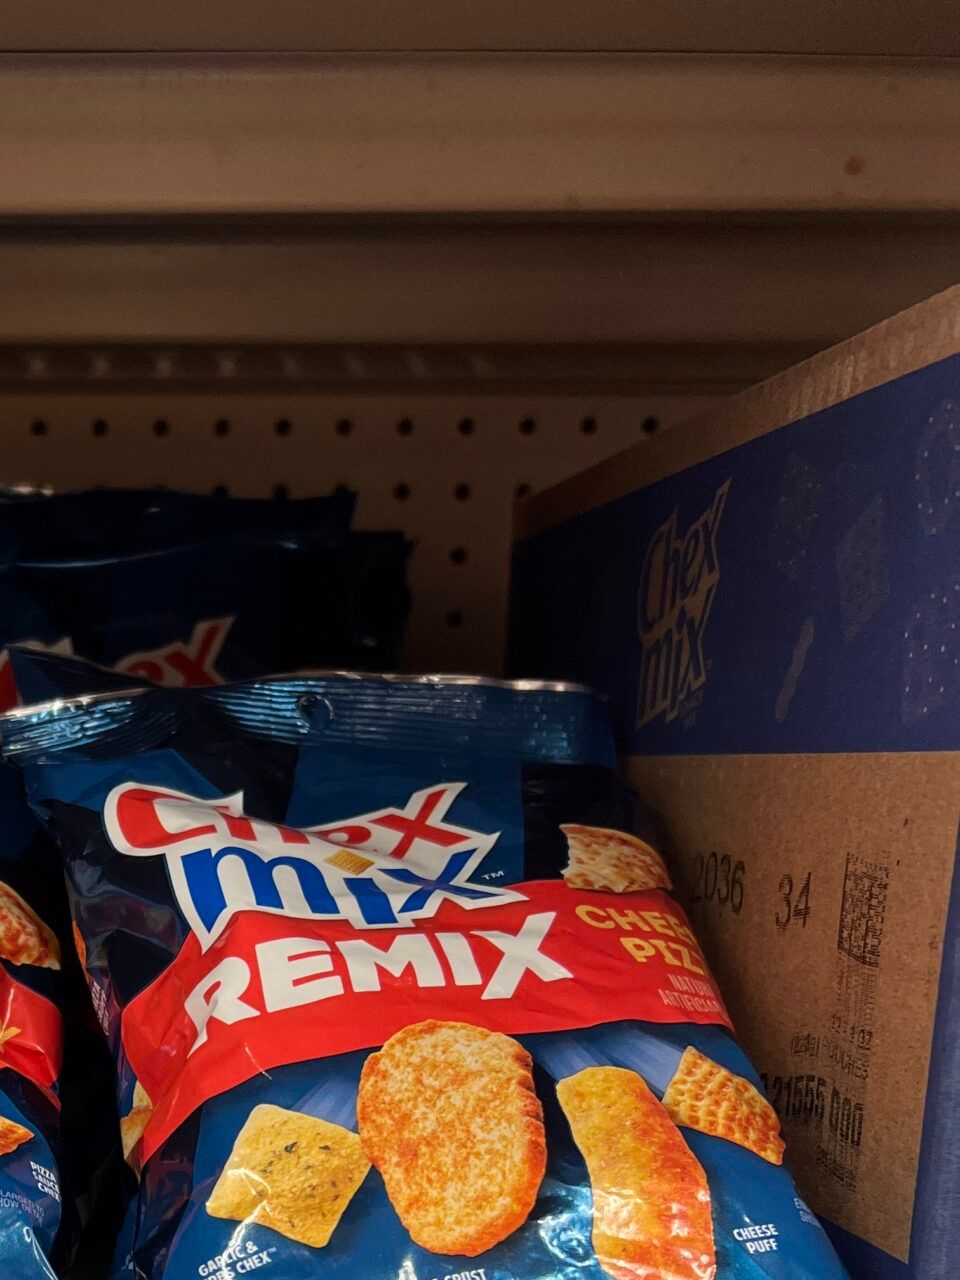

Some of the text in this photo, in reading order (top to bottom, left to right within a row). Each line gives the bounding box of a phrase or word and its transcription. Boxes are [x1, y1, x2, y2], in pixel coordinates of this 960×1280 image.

[639, 478, 731, 638] Chex
[638, 592, 720, 728] mix
[181, 845, 512, 936] mix
[775, 871, 812, 932] 34
[184, 911, 574, 1058] REMIX
[197, 1241, 258, 1277] GARLIC &
[732, 1224, 779, 1242] CHEESE
[746, 1238, 779, 1255] PUFF
